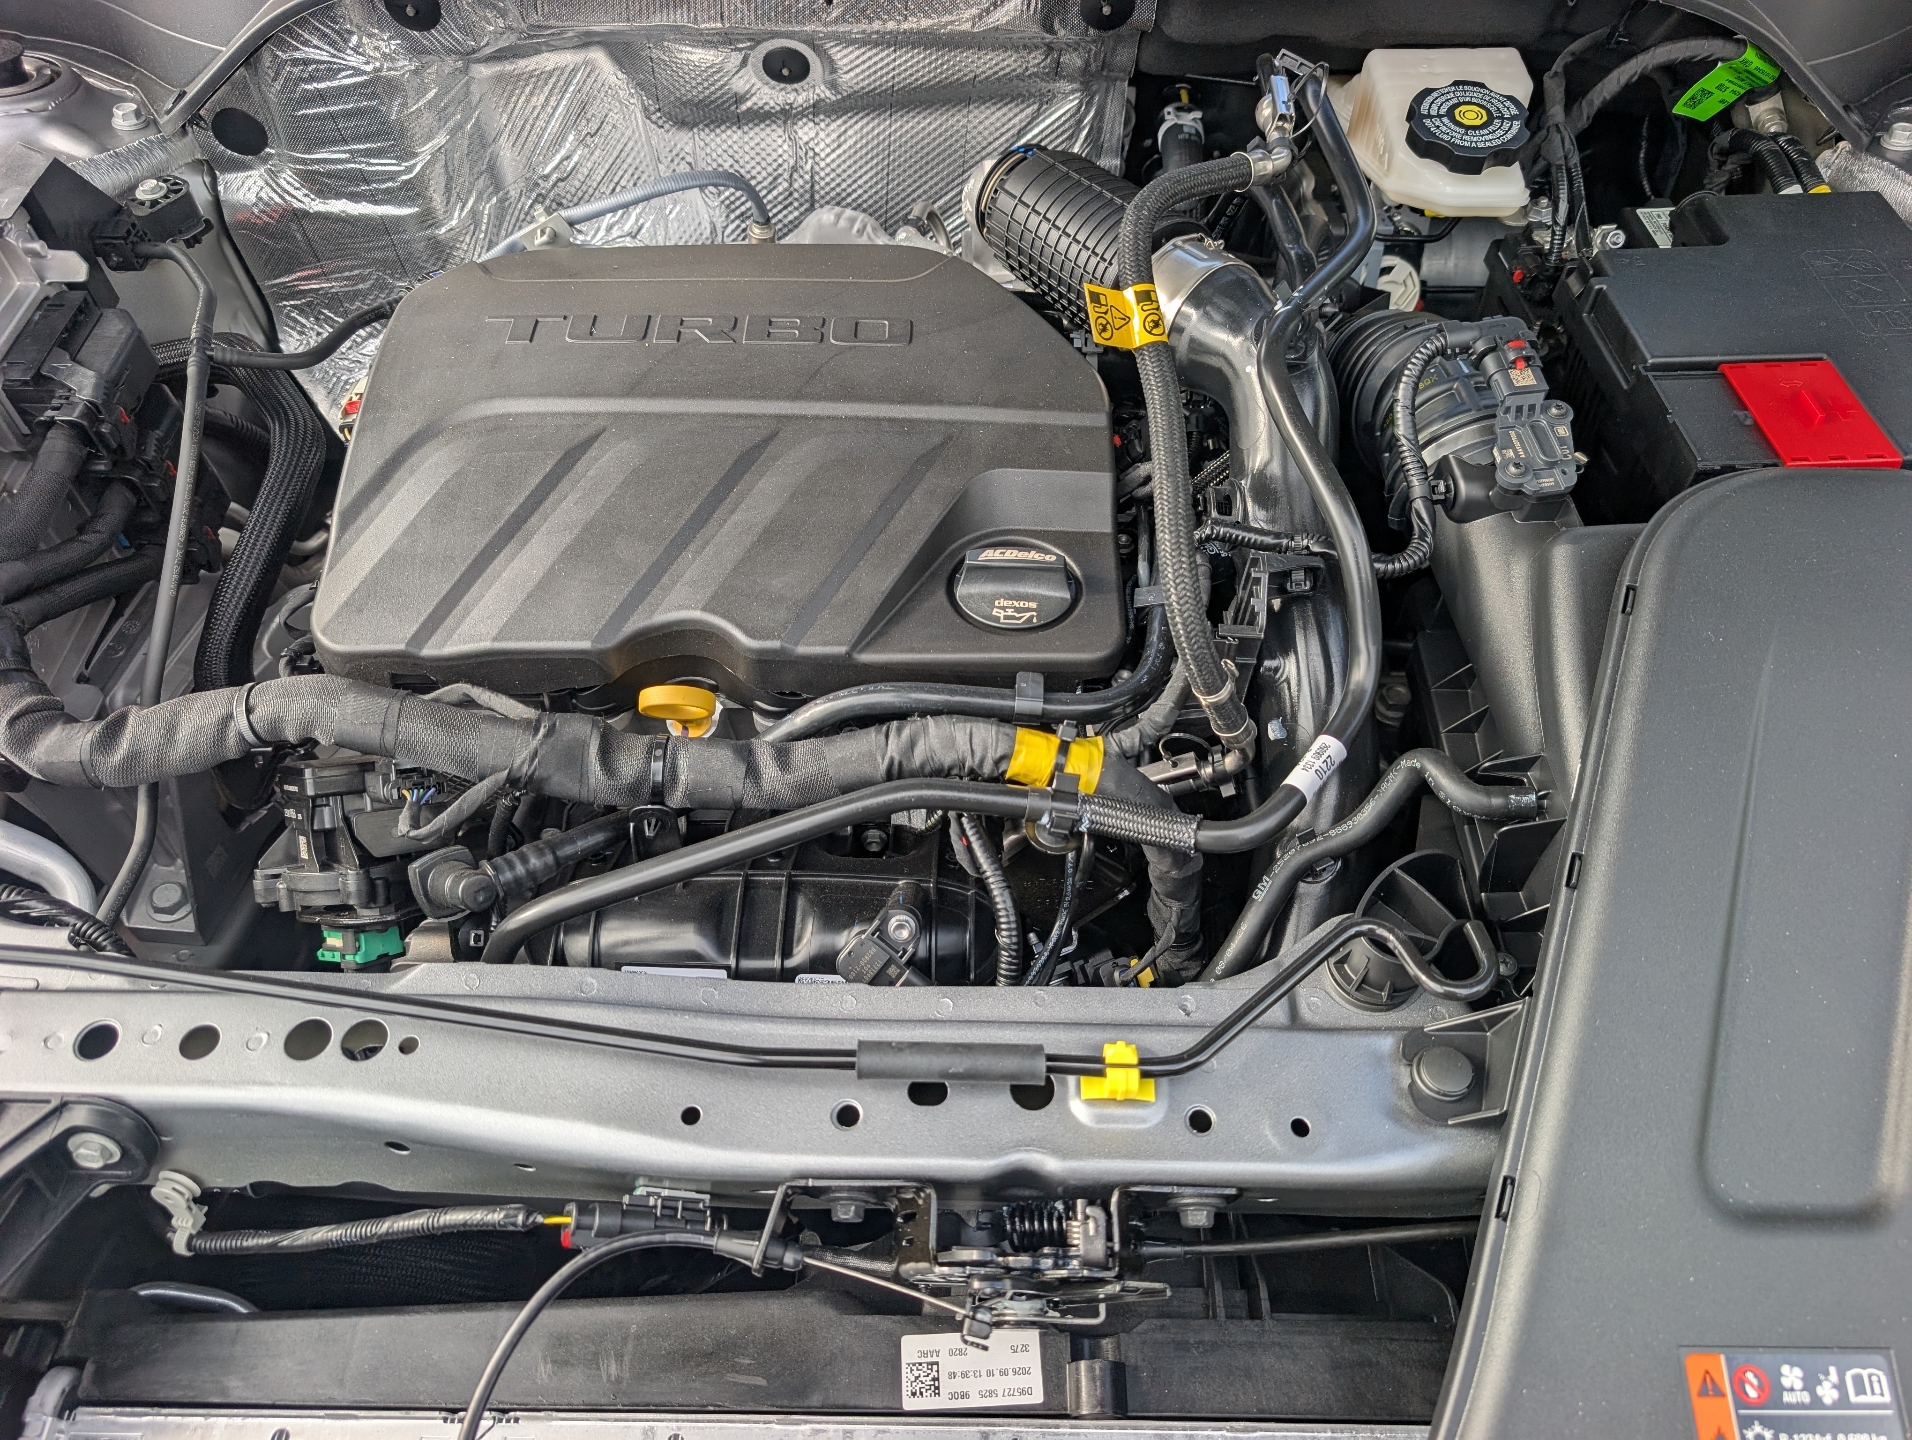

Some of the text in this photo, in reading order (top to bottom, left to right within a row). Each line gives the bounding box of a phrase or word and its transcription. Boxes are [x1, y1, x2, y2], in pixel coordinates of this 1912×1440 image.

[1432, 118, 1443, 128] CAP
[1439, 125, 1462, 139] BEFORE
[1487, 120, 1501, 132] FILLER
[1433, 129, 1451, 140] FLUID
[1451, 137, 1470, 147] FROM
[486, 314, 914, 346] TURBO
[978, 549, 1057, 562] ACDelco
[994, 598, 1038, 609] dexos
[1314, 755, 1335, 780] 2210
[917, 1344, 1030, 1358] 3275 2820 AARC
[948, 1366, 1032, 1380] 2026.09.10 13:39:48
[948, 1386, 1033, 1400] D95727 5825 9BQC
[1782, 1390, 1810, 1404] AUTO
